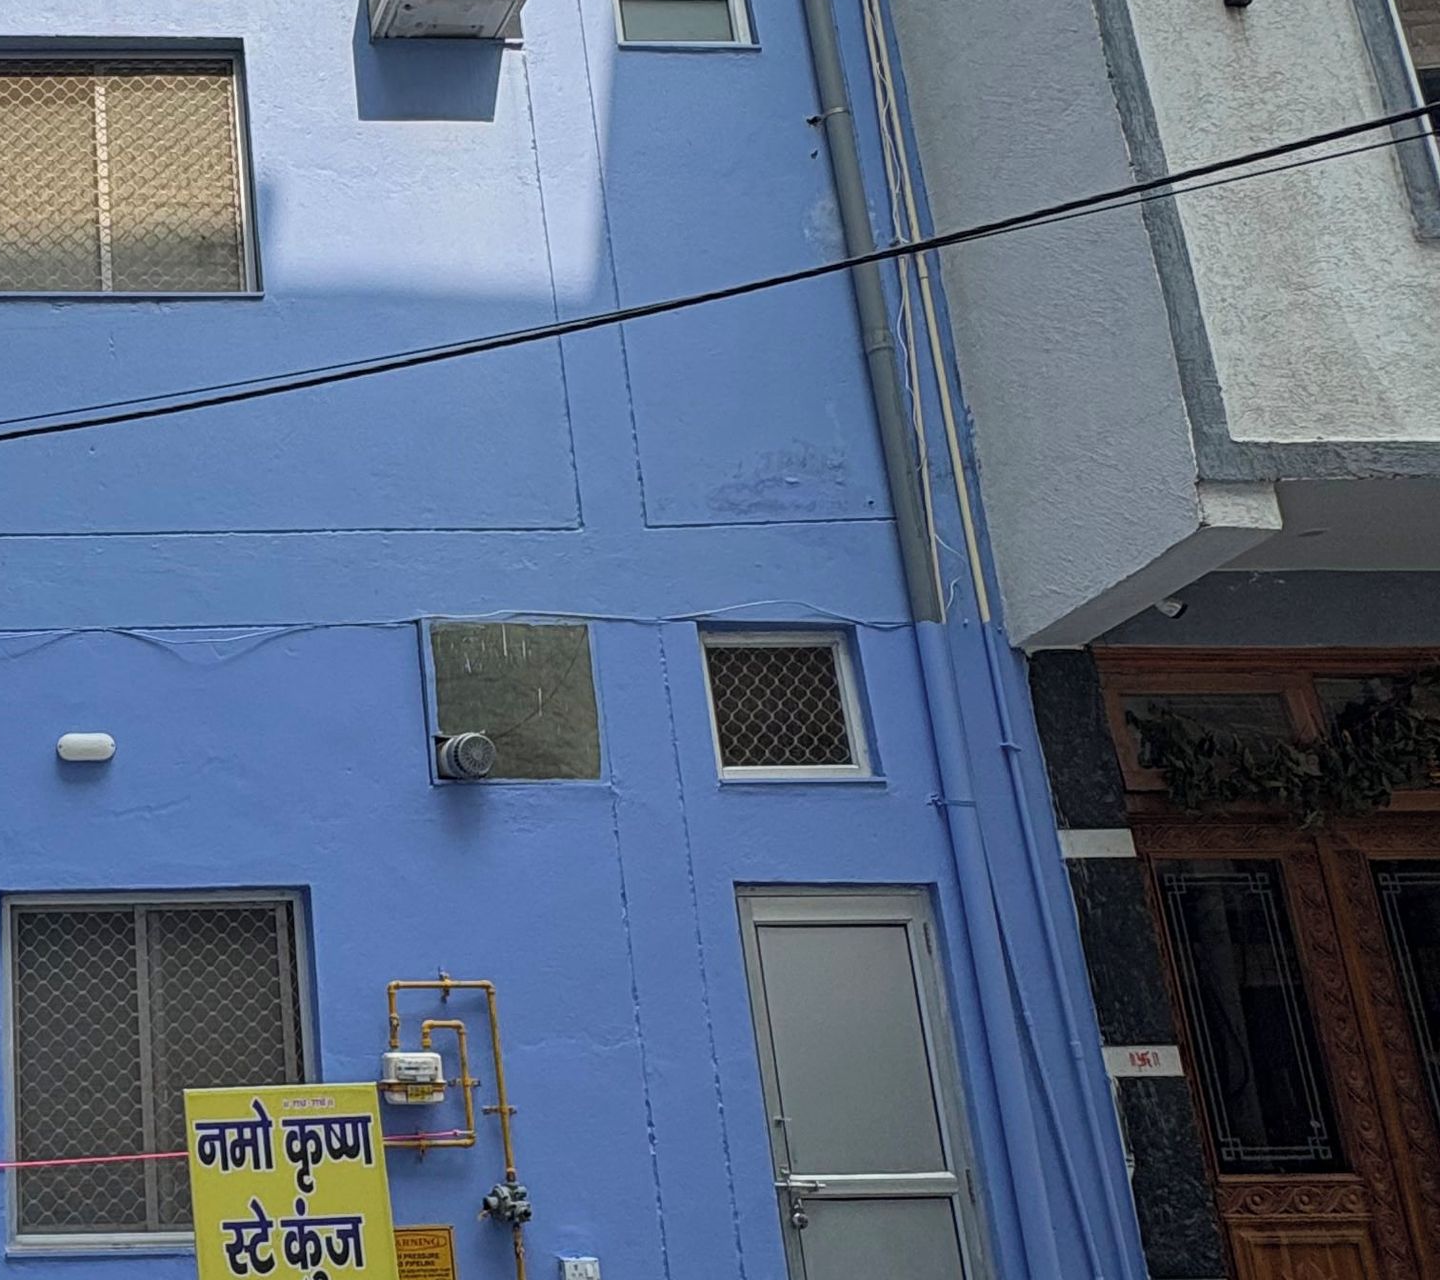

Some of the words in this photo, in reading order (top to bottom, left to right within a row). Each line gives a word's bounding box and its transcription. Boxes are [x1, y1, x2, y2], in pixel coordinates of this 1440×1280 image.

[195, 1098, 274, 1171] नमो
[281, 1114, 373, 1194] कृष्ण
[221, 1199, 276, 1275] स्टे
